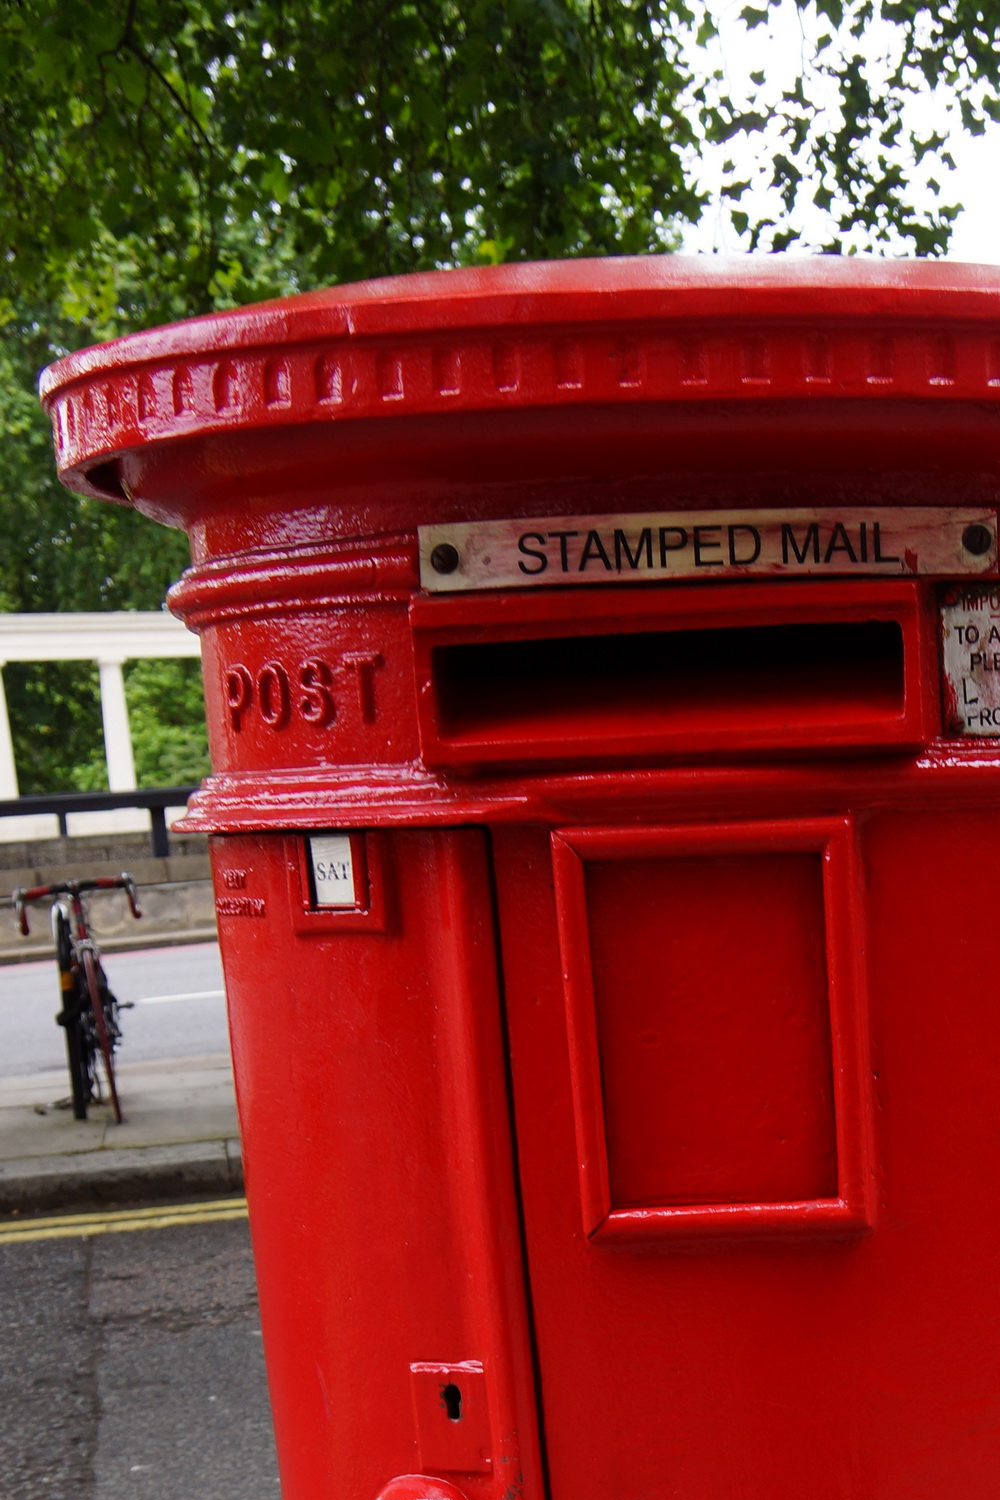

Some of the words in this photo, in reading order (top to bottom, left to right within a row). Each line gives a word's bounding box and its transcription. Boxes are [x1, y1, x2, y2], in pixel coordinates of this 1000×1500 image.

[516, 523, 762, 576] STAMPED
[780, 521, 902, 565] MAIL
[953, 625, 981, 645] TO
[223, 650, 385, 732] POST
[315, 861, 351, 882] SAT
